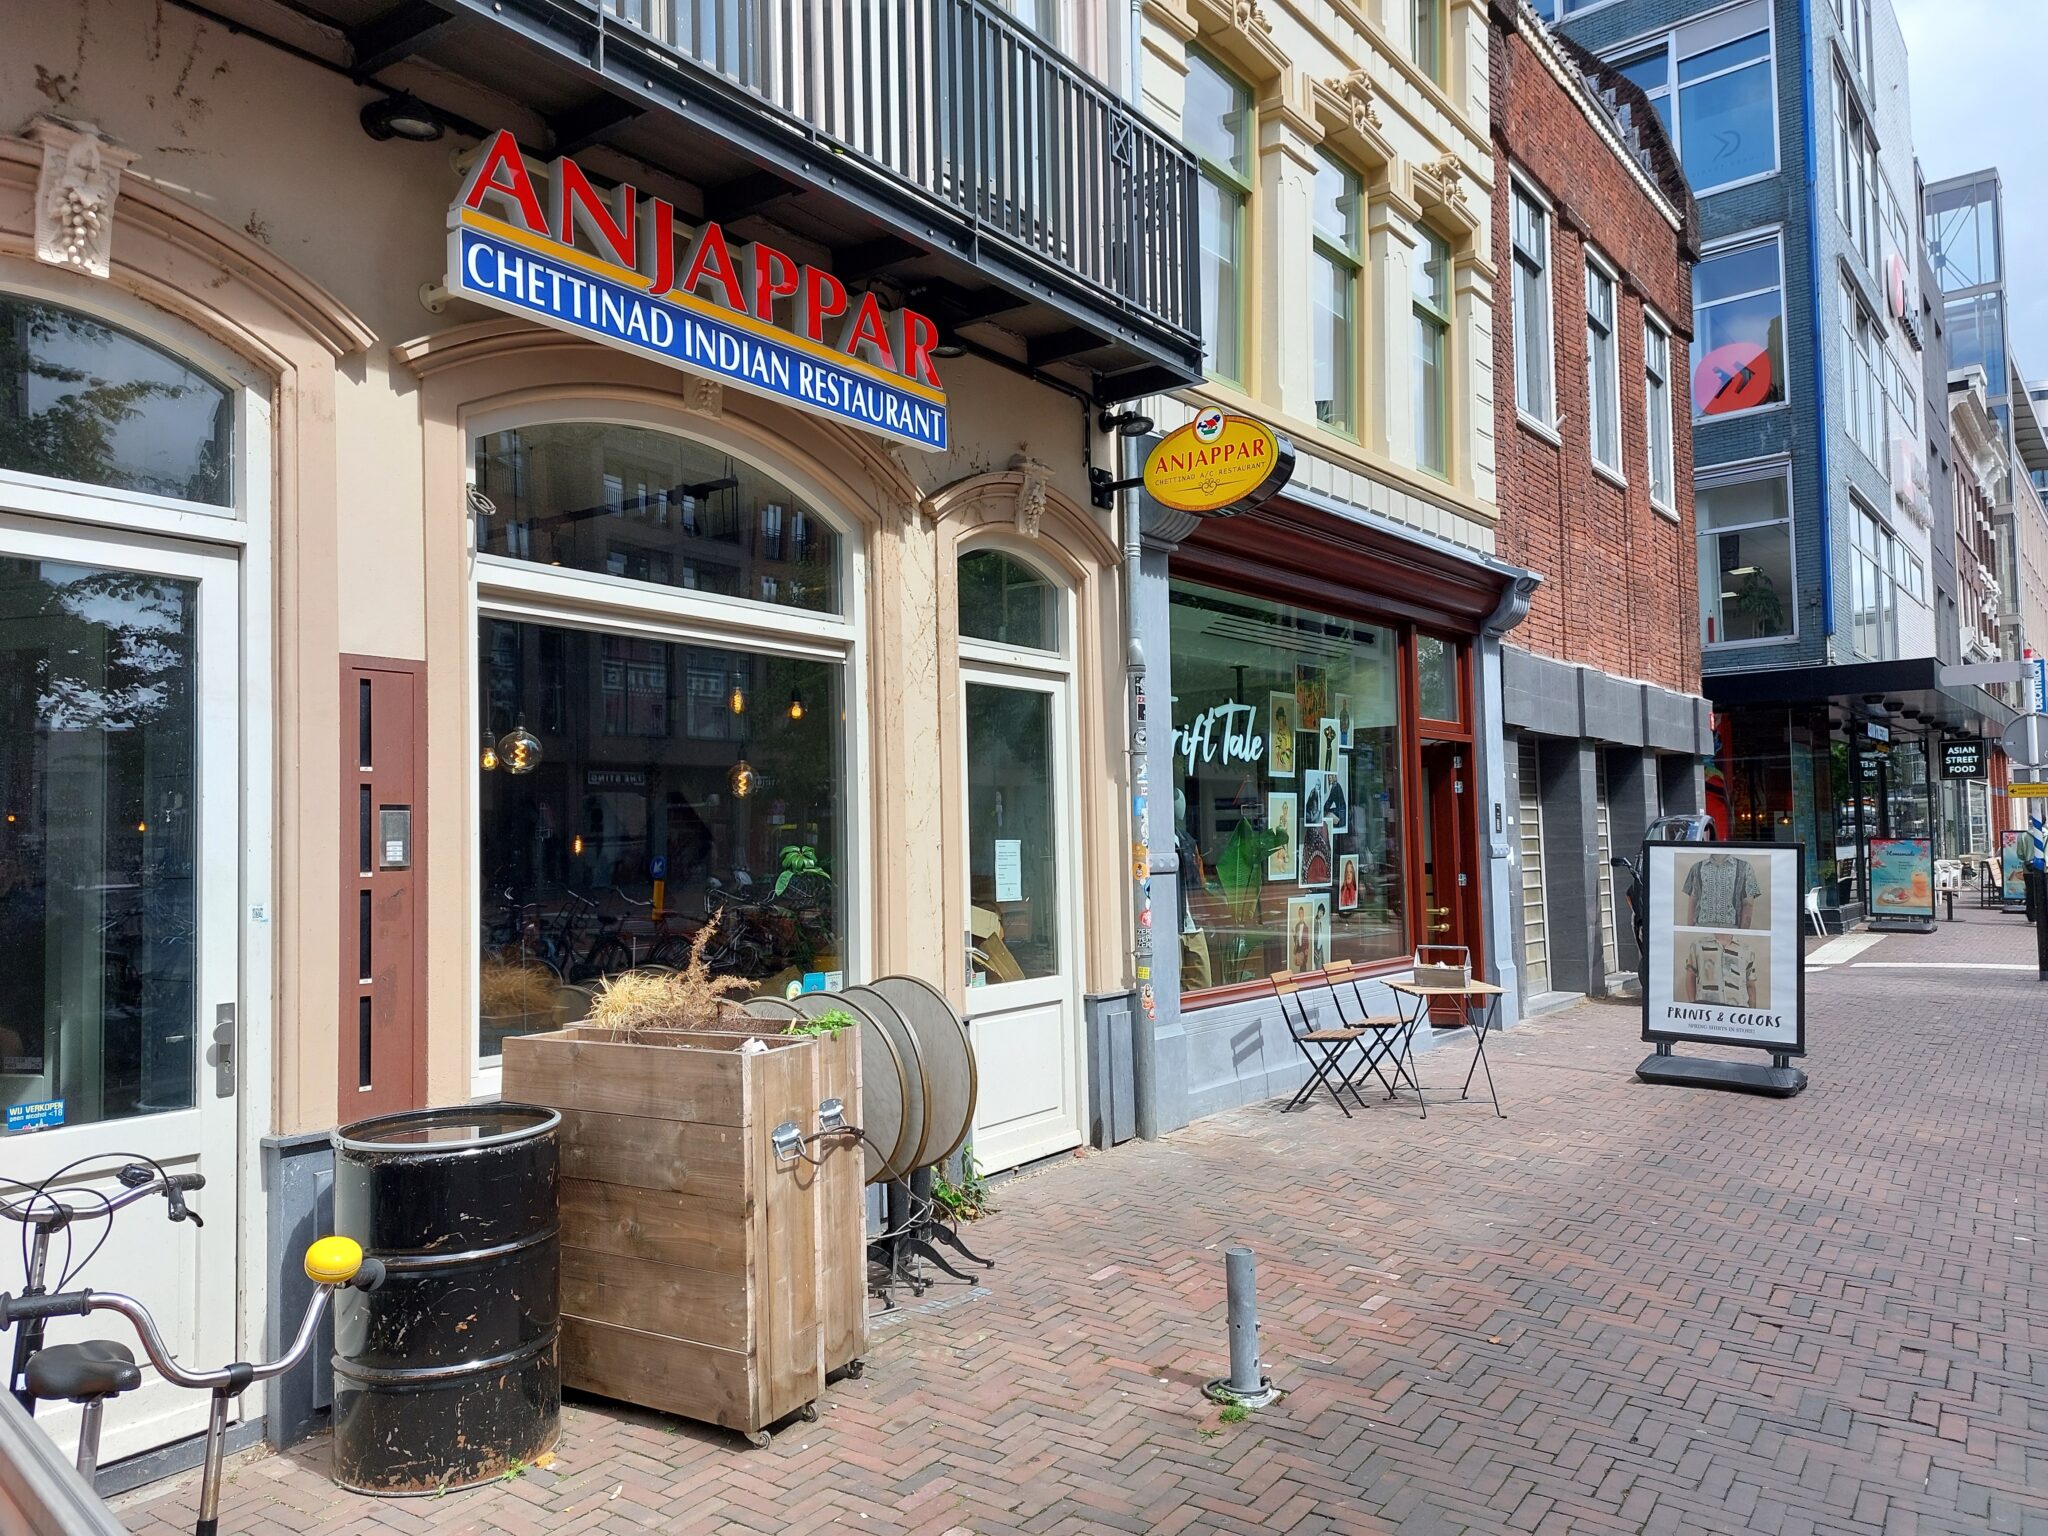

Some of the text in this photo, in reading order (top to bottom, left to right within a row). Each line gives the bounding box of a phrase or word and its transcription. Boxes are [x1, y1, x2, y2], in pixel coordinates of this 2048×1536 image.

[461, 128, 943, 389] ANJAPPAR
[467, 242, 944, 443] CHETTINAD INDIAN RESTAURANT
[1155, 438, 1265, 474] ANJAPPAR
[1154, 461, 1267, 487] CHETTINAD A/C RESTAURANT
[2034, 661, 2043, 711] DECATHLON
[1171, 696, 1264, 777] rift Tale
[1945, 755, 1980, 764] STREET
[1947, 746, 1976, 755] ASIAN
[1949, 765, 1976, 774] FOOD
[1667, 1006, 1782, 1028] PRINTS & COLORS
[25, 1101, 64, 1114] VERKOPEN
[25, 1112, 47, 1120] alcohol
